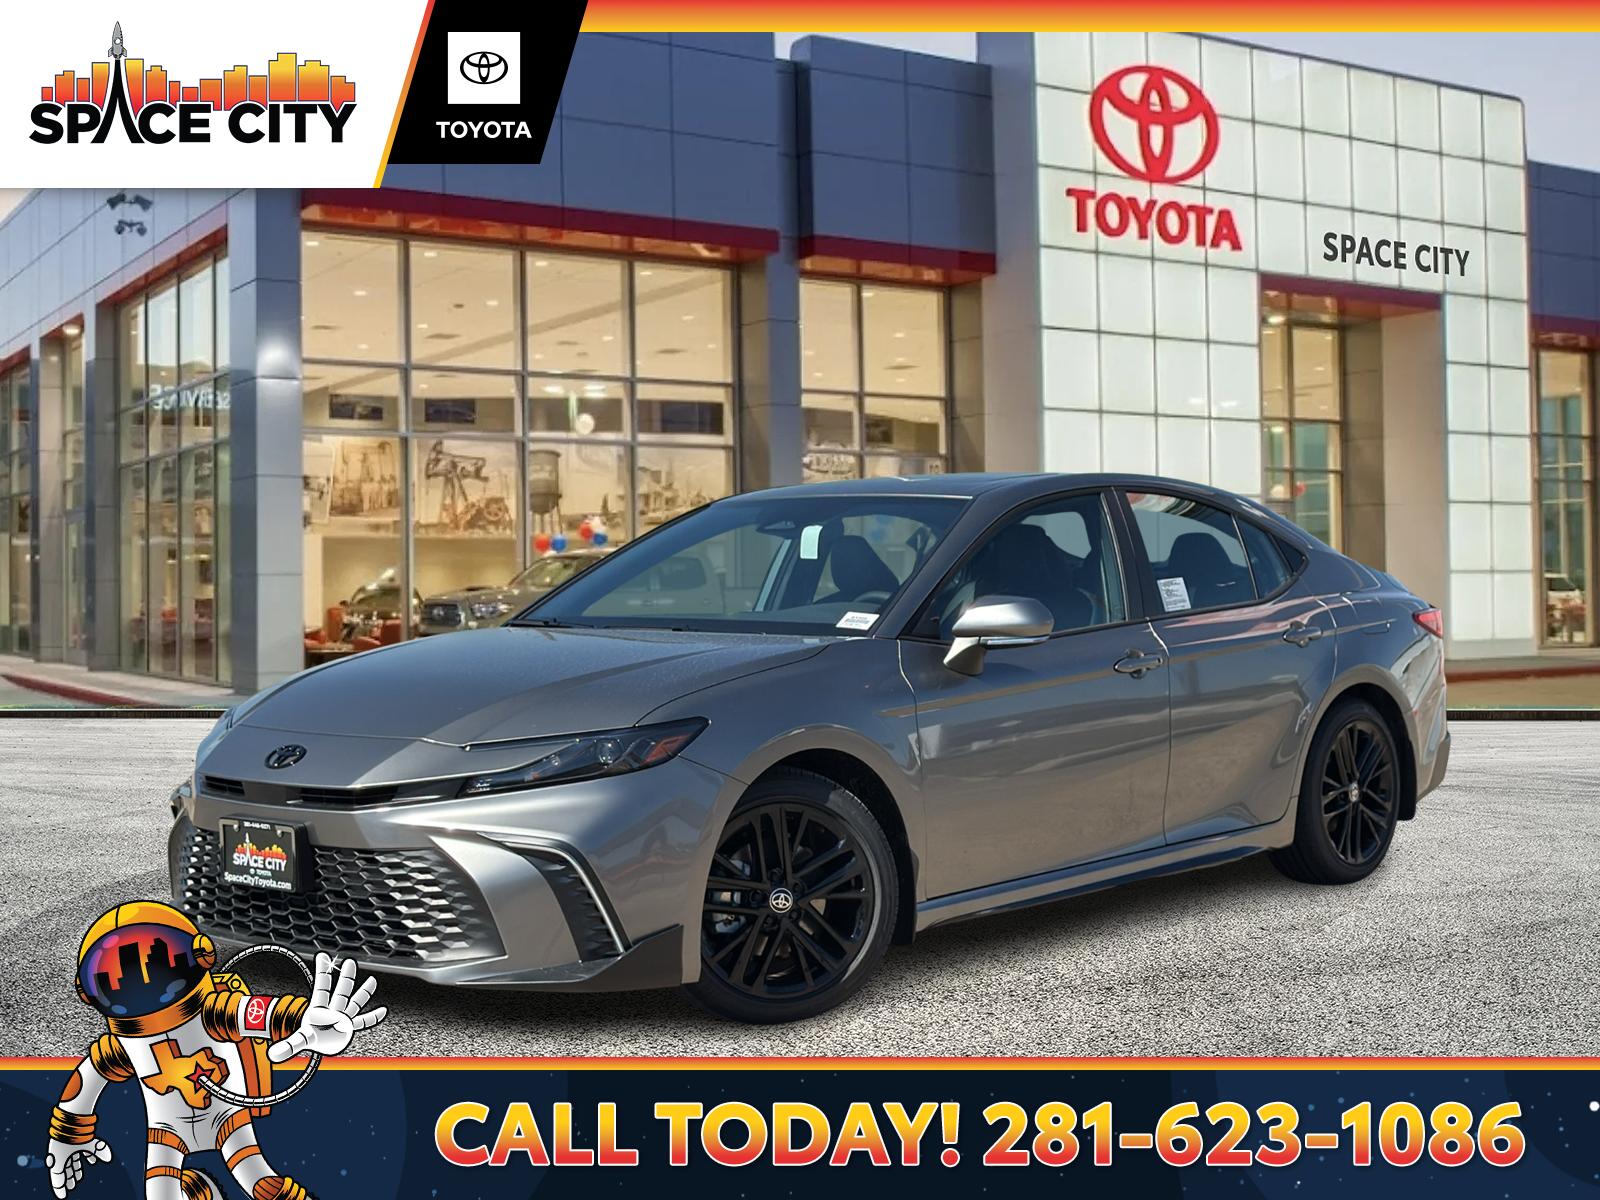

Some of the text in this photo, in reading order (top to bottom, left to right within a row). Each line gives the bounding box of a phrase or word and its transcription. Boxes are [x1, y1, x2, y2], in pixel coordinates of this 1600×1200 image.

[1066, 187, 1243, 251] TOYOTA
[1322, 231, 1471, 277] SPACE CITY
[233, 848, 287, 872] SPACE CITY
[224, 871, 292, 890] SpaceCityToyota.com
